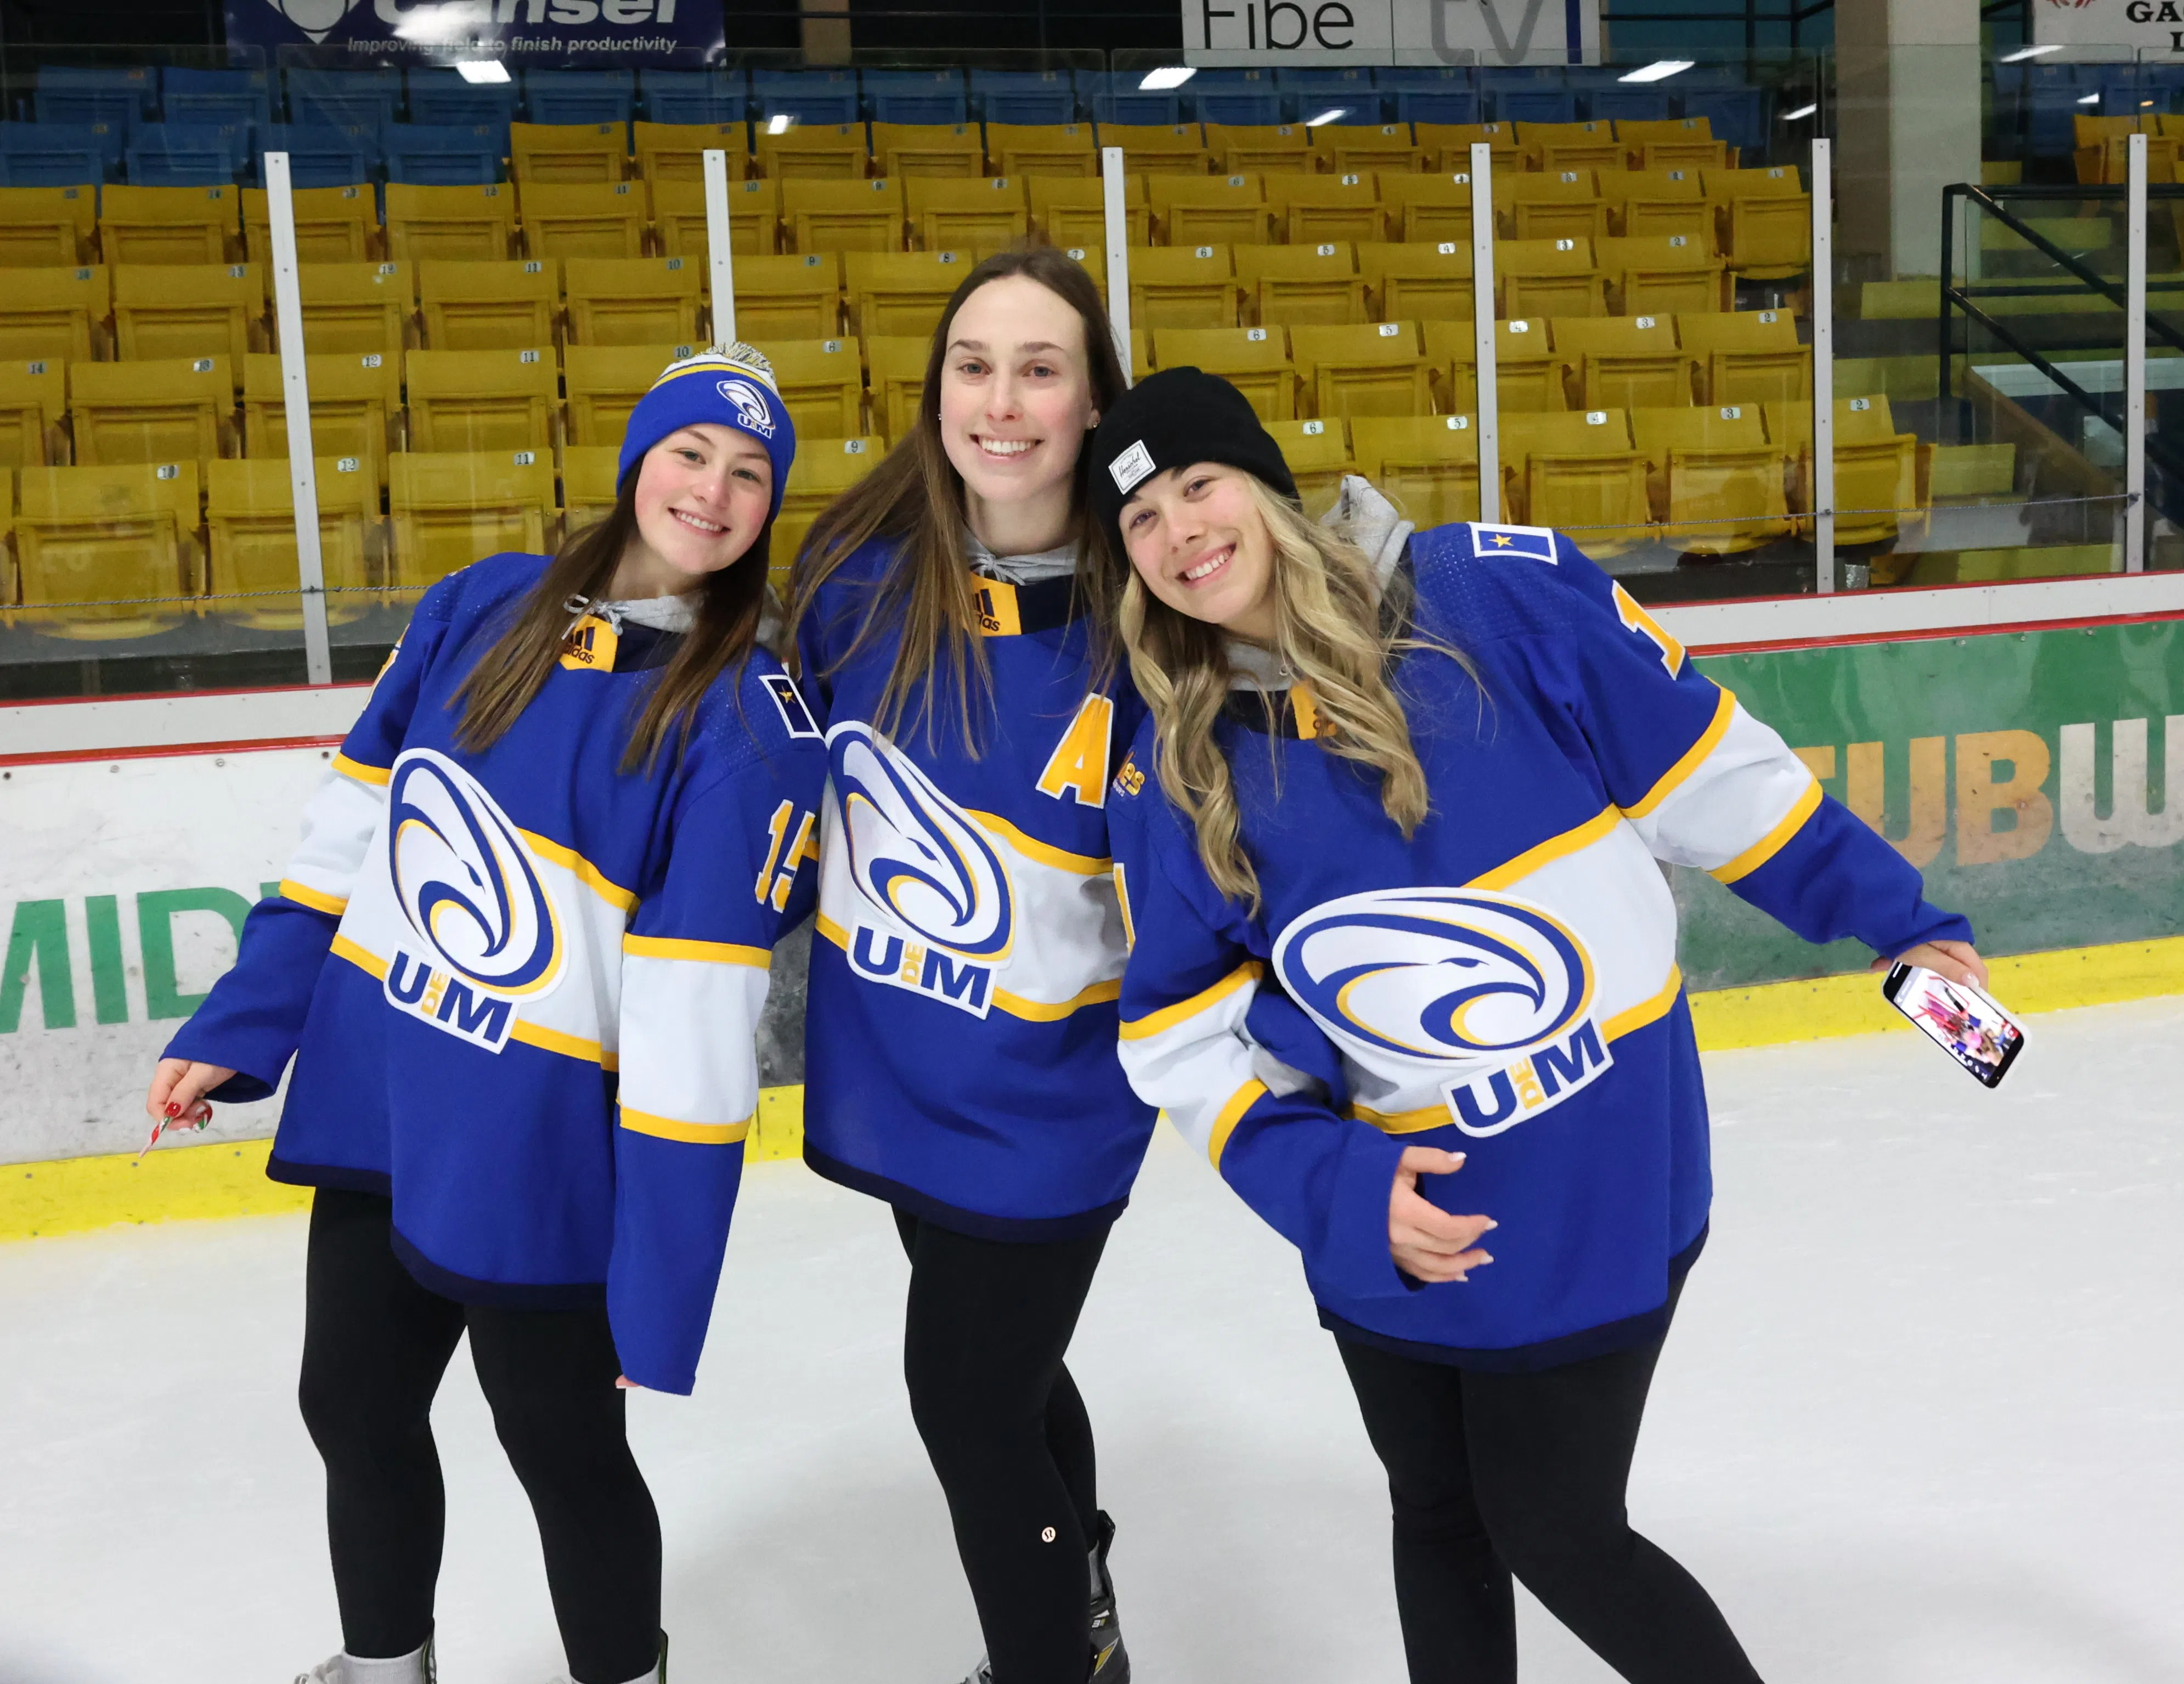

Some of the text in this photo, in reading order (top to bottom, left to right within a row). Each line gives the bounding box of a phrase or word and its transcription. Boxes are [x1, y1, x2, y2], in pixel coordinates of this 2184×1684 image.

[2126, 1, 2184, 24] GA
[1202, 0, 1354, 49] Fibe
[1431, 0, 1542, 65] tv
[511, 36, 562, 52] finish
[567, 36, 678, 54] productivity
[617, 185, 626, 194] 11
[1561, 240, 1568, 251] 3
[1674, 236, 1681, 246] 2
[1200, 247, 1207, 258] 6
[1323, 246, 1329, 256] 5
[1443, 244, 1450, 253] 4
[943, 253, 950, 263] 8
[1073, 250, 1079, 260] 7
[528, 263, 537, 273] 11
[669, 259, 681, 270] 10
[1641, 318, 1649, 328] 3
[1764, 313, 1770, 323] 2
[1253, 330, 1260, 341] 6
[1385, 326, 1392, 335] 5
[523, 352, 534, 362] 11
[676, 346, 690, 358] 10
[365, 355, 378, 367] 12
[31, 363, 43, 374] 14
[1856, 399, 1864, 410] 2
[1592, 414, 1600, 423] 4
[1726, 408, 1734, 419] 3
[1310, 422, 1317, 433] 6
[1454, 419, 1461, 430] 5
[851, 440, 859, 454] 9
[517, 454, 529, 465] 11
[1119, 451, 1141, 478] Herschel
[342, 459, 356, 472] 12
[1036, 693, 1114, 809] A
[1793, 715, 2184, 867] UBW
[0, 881, 280, 1034] MID
